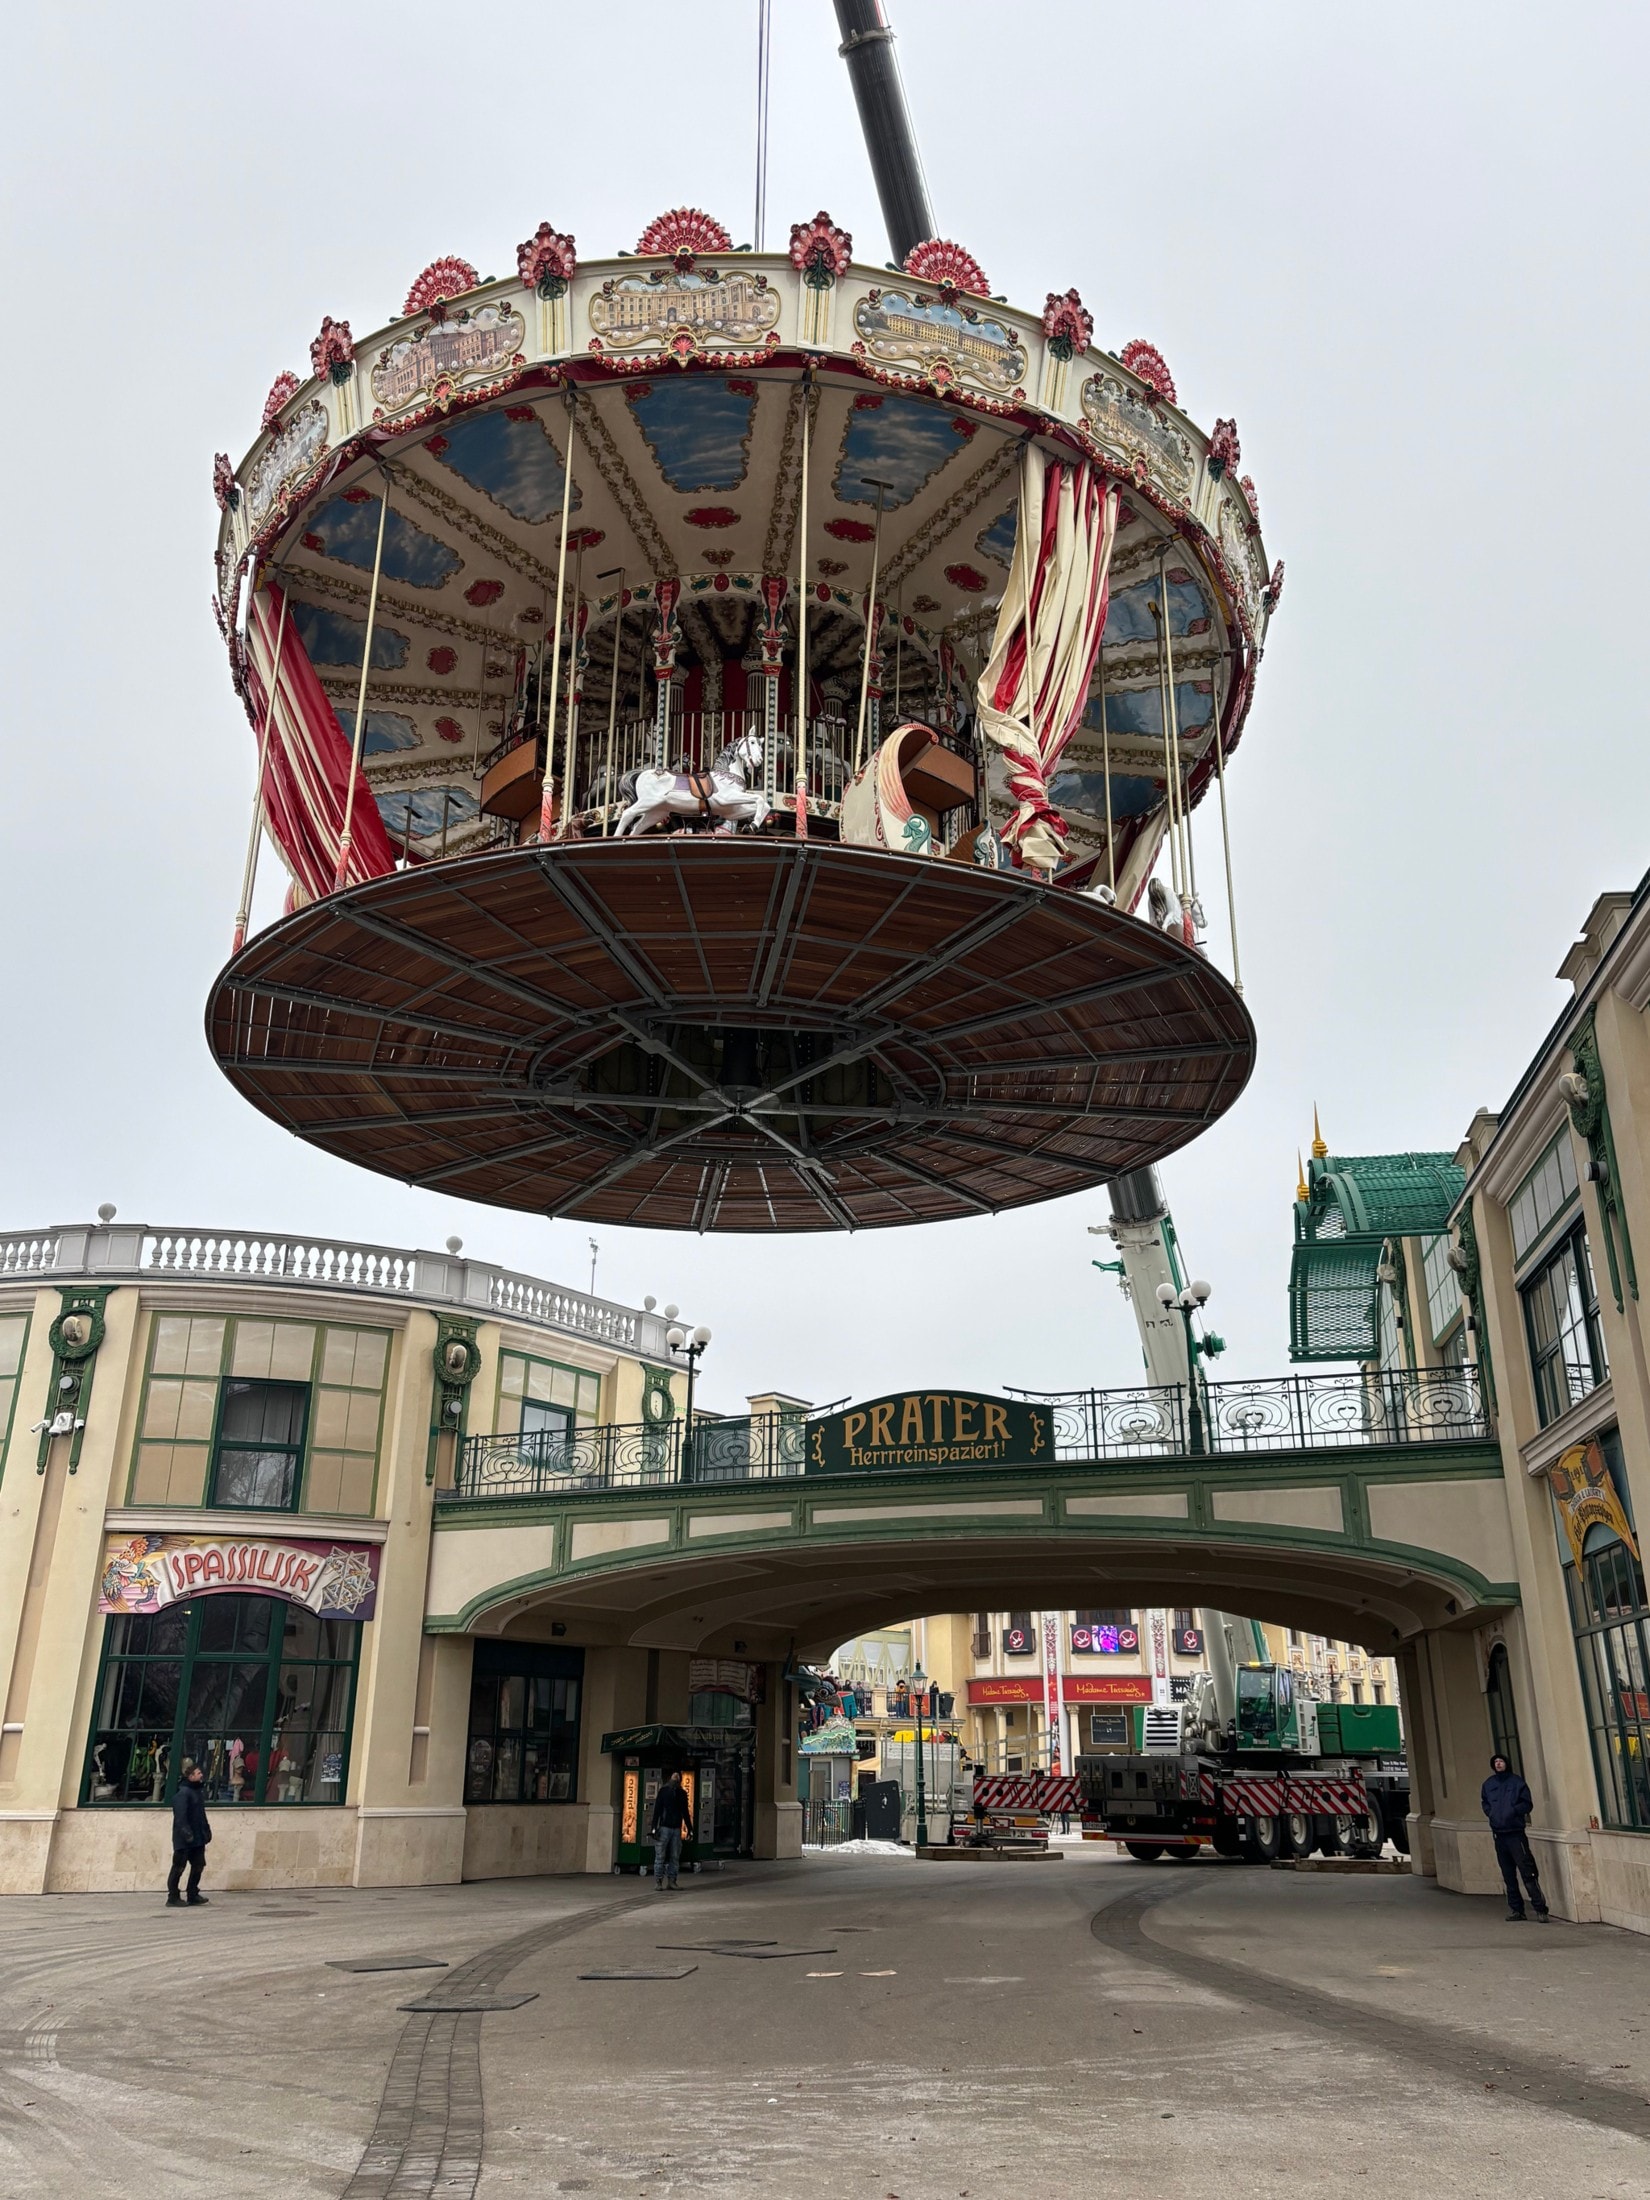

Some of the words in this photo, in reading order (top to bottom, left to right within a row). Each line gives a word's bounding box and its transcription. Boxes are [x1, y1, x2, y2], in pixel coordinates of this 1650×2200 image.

[842, 1395, 1012, 1448] PRATER
[850, 1440, 1006, 1466] Herrrreinspaziert!
[172, 1545, 319, 1592] SPASSILISK
[1076, 1683, 1108, 1695] Madame
[1105, 1682, 1141, 1698] Tussauds
[626, 1778, 634, 1810] photo
